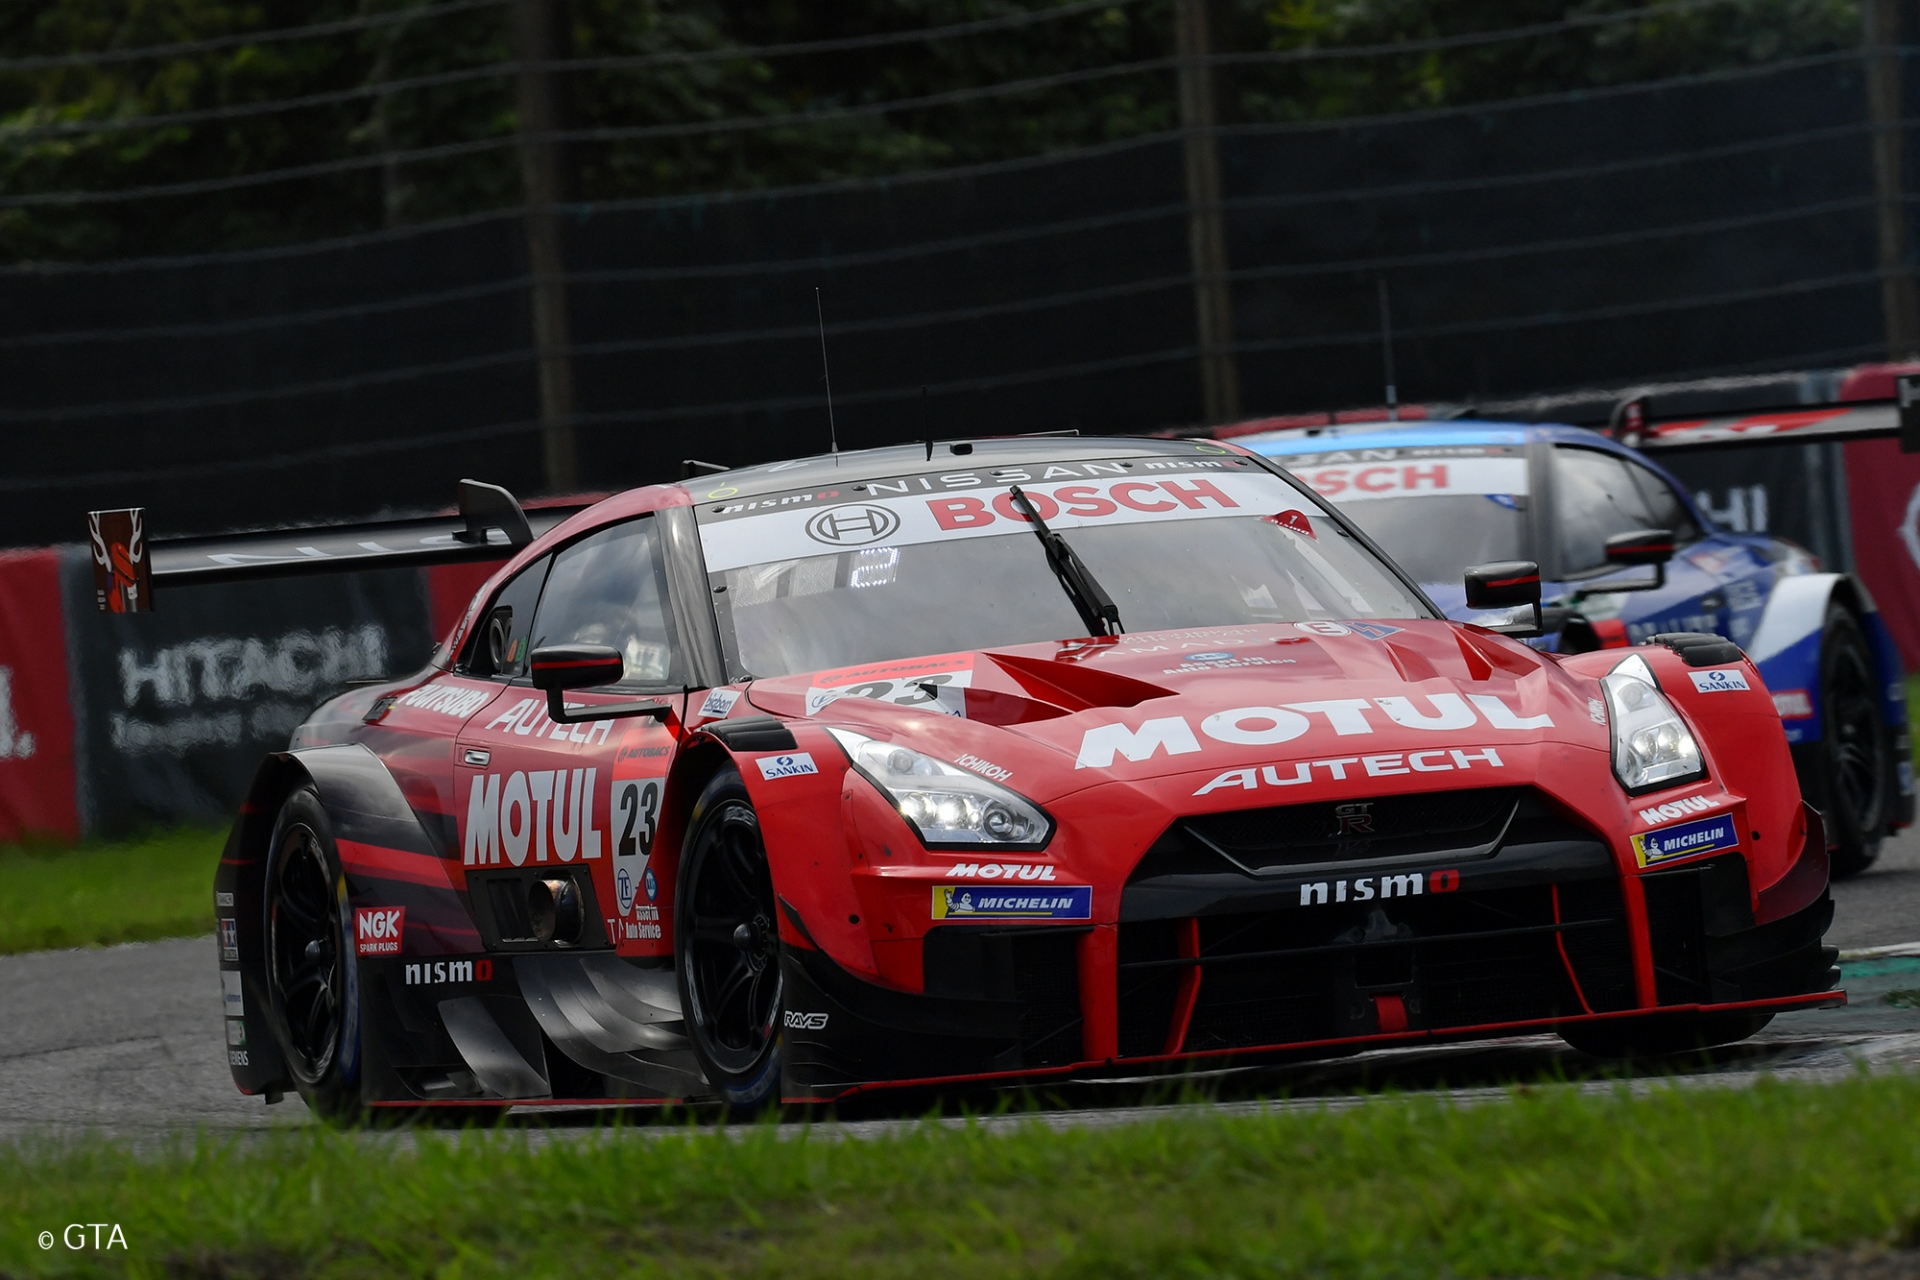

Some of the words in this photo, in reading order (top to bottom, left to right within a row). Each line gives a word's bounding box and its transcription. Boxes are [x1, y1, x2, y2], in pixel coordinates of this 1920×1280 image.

[1145, 458, 1242, 470] nismo
[866, 462, 1129, 497] NISSAN
[1295, 465, 1449, 496] SCH
[722, 490, 839, 515] nismo
[926, 479, 1240, 531] BOSCH
[1289, 515, 1298, 524] 1
[119, 625, 388, 707] HITACHI
[1699, 680, 1748, 691] SANKIN
[396, 684, 490, 719] FUJITSUBO
[1075, 692, 1556, 770] MOTUL
[765, 762, 815, 779] SANKIN
[954, 753, 1013, 782] ICHIKOH
[1192, 748, 1504, 796] AUTECH
[464, 767, 602, 867] MOTUL
[618, 782, 658, 857] 23
[1335, 802, 1374, 815] GT
[1639, 795, 1721, 826] MOTUL
[1336, 814, 1375, 834] R
[1663, 826, 1724, 851] MICHELIN
[946, 863, 1057, 881] MOTUL
[617, 873, 632, 904] ZF
[1300, 869, 1460, 907] nismo
[978, 897, 1074, 909] MICHELIN
[359, 910, 400, 939] NGK
[360, 943, 377, 953] SPARK
[378, 942, 398, 952] PLUGS
[406, 960, 493, 985] nismo
[784, 1010, 829, 1030] RAYS
